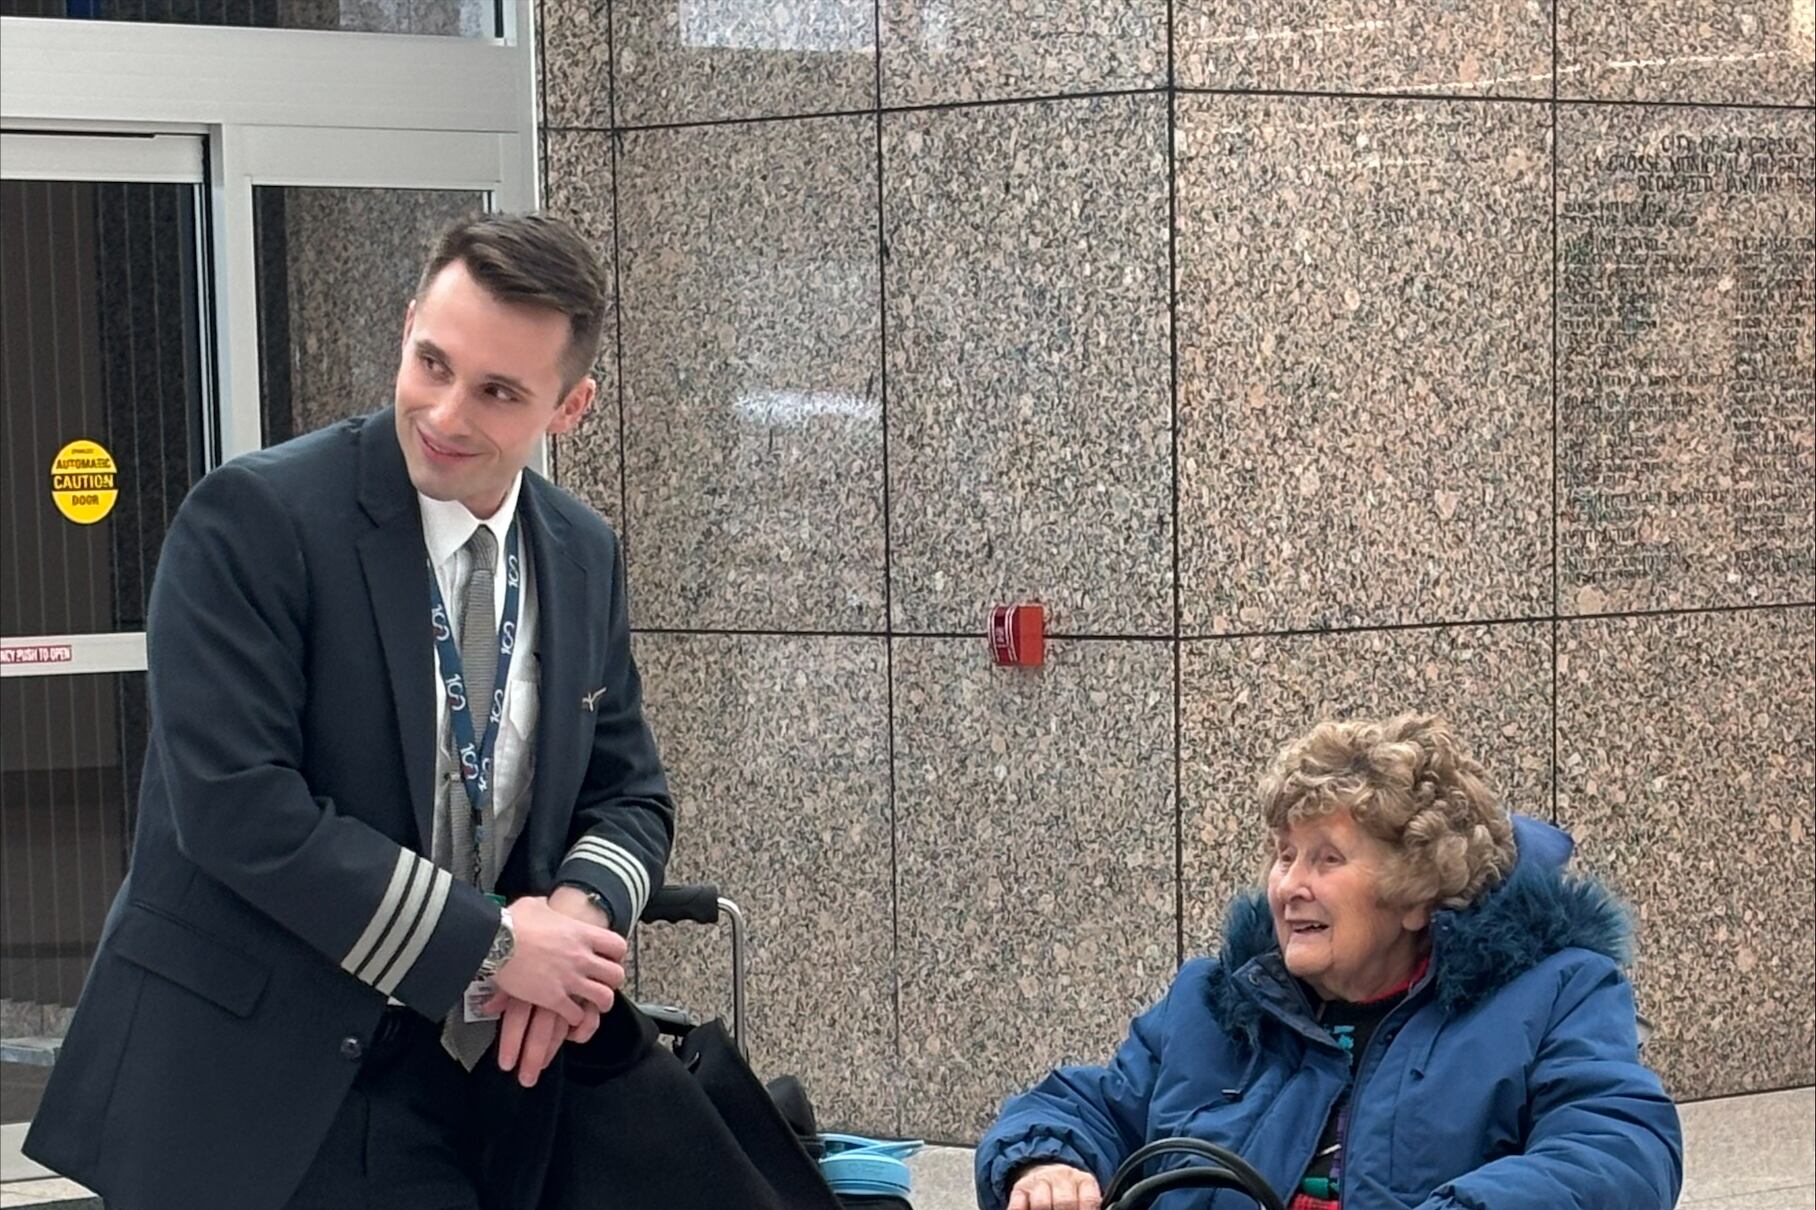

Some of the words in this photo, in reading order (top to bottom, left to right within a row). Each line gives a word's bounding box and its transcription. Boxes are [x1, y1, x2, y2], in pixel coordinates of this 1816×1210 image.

[56, 458, 112, 469] AUTOMATIC
[53, 474, 115, 490] CAUTION
[71, 494, 100, 506] DOOR
[16, 648, 38, 662] PUSH
[39, 647, 49, 661] TO
[50, 647, 71, 660] OPEN
